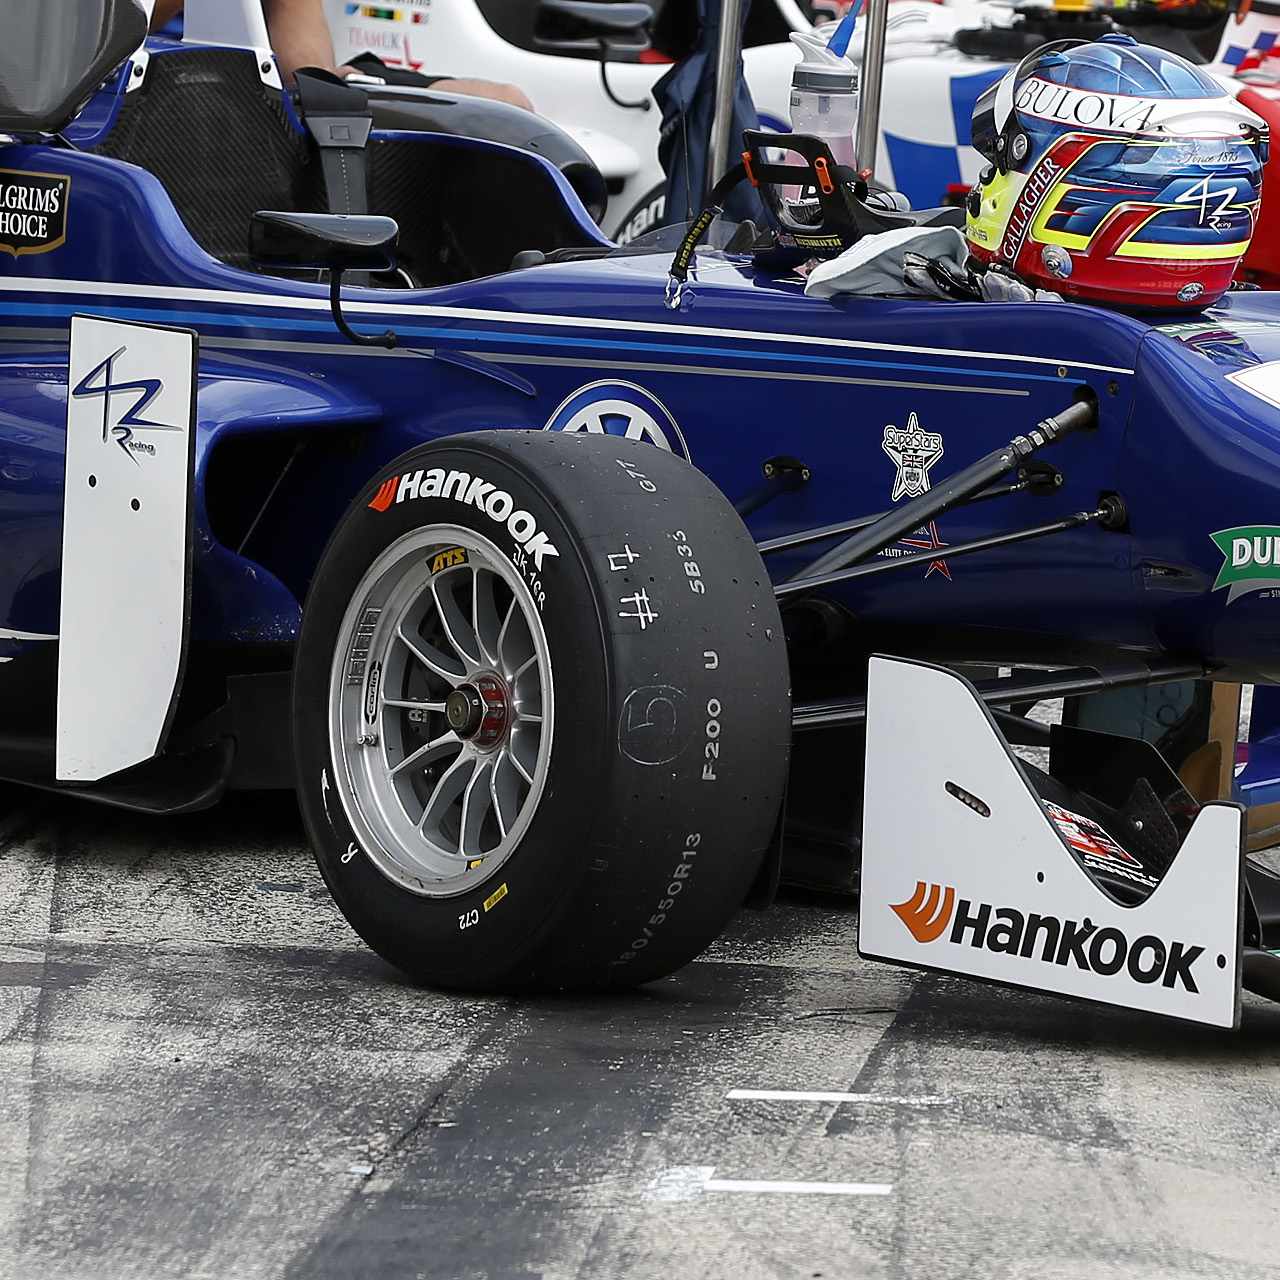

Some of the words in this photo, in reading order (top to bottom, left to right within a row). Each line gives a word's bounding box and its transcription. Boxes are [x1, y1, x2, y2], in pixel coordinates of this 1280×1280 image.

[1014, 78, 1166, 133] BULOVA
[1002, 156, 1062, 261] GALLAGHER
[431, 546, 467, 575] ATS
[701, 696, 723, 782] F200
[458, 907, 480, 931] C72
